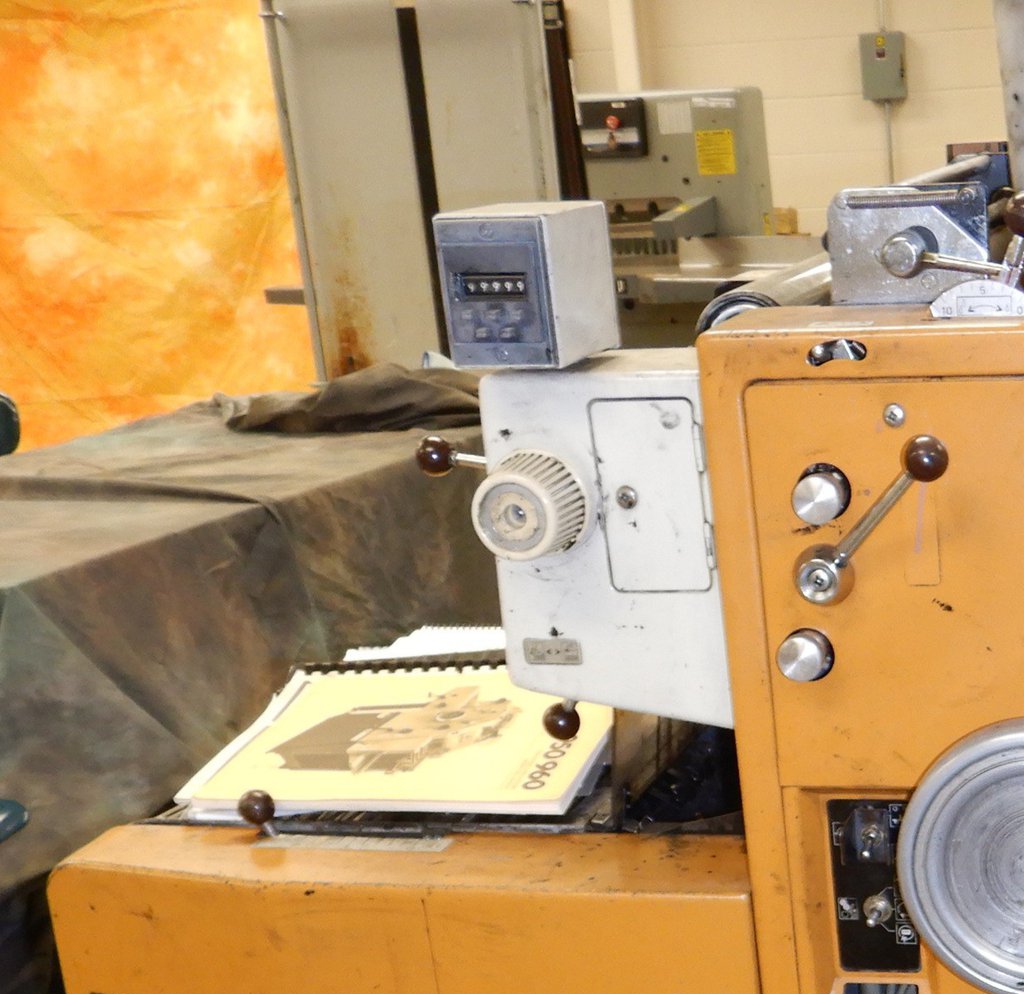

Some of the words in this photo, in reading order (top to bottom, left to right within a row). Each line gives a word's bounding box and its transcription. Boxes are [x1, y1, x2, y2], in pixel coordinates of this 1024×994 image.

[980, 287, 986, 295] 5
[1016, 306, 1024, 315] 0
[543, 735, 578, 759] 50
[522, 761, 558, 790] 960
